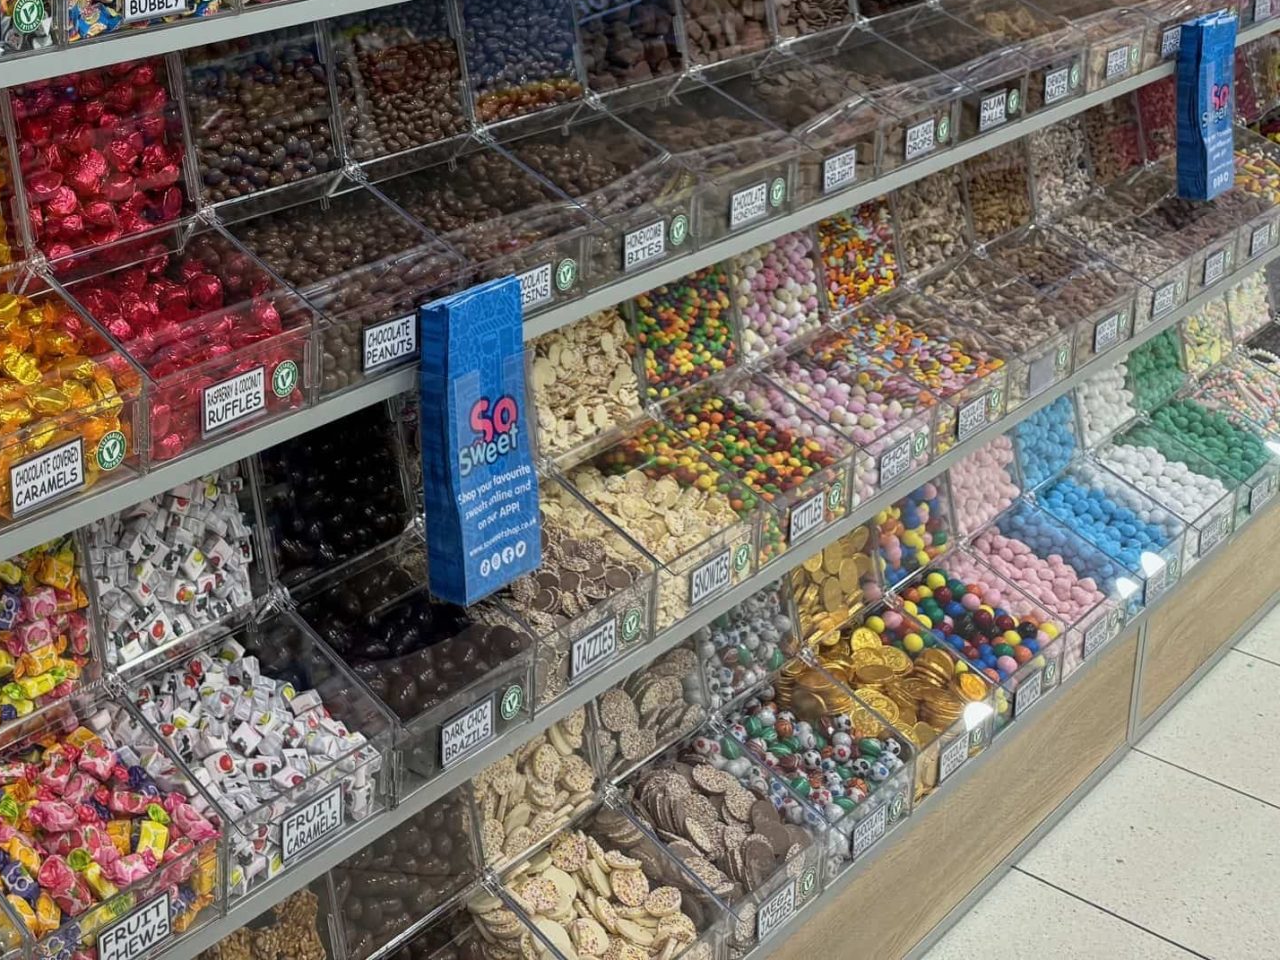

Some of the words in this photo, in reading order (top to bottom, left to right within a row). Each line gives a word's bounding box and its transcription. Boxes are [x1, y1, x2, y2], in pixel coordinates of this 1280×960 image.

[982, 98, 1006, 114] RUM
[982, 108, 1005, 126] BALLS
[907, 136, 933, 156] DROPS
[826, 166, 854, 188] DELIGHT
[734, 185, 765, 211] CHOCOLATE
[734, 203, 765, 223] HONEYCOMB
[627, 223, 662, 248] HONEYCOMB
[627, 240, 662, 265] BITES
[368, 318, 411, 349] CHOCOLATE
[366, 339, 413, 367] PEANUTS
[206, 385, 234, 409] RASPBERRY
[239, 372, 262, 394] COCONUT
[207, 394, 262, 427] RUFFLES
[15, 461, 51, 488] CHOCOLATE
[51, 450, 79, 474] COVERED
[458, 489, 477, 506] Shop
[478, 479, 493, 498] your
[493, 463, 531, 486] favourite
[15, 468, 79, 507] CARAMELS
[515, 479, 532, 495] and
[478, 519, 487, 530] on
[791, 496, 823, 538] SKITTLES
[692, 554, 730, 602] SNOWIES
[572, 625, 615, 674] JAZZIES
[442, 718, 467, 746] DARK
[467, 707, 491, 735] CHOC
[443, 727, 491, 765] BRAZILS
[286, 794, 336, 837] FRUIT
[286, 811, 338, 856] CARAMELS
[760, 887, 792, 922] MEGA
[102, 898, 166, 953] FRUIT
